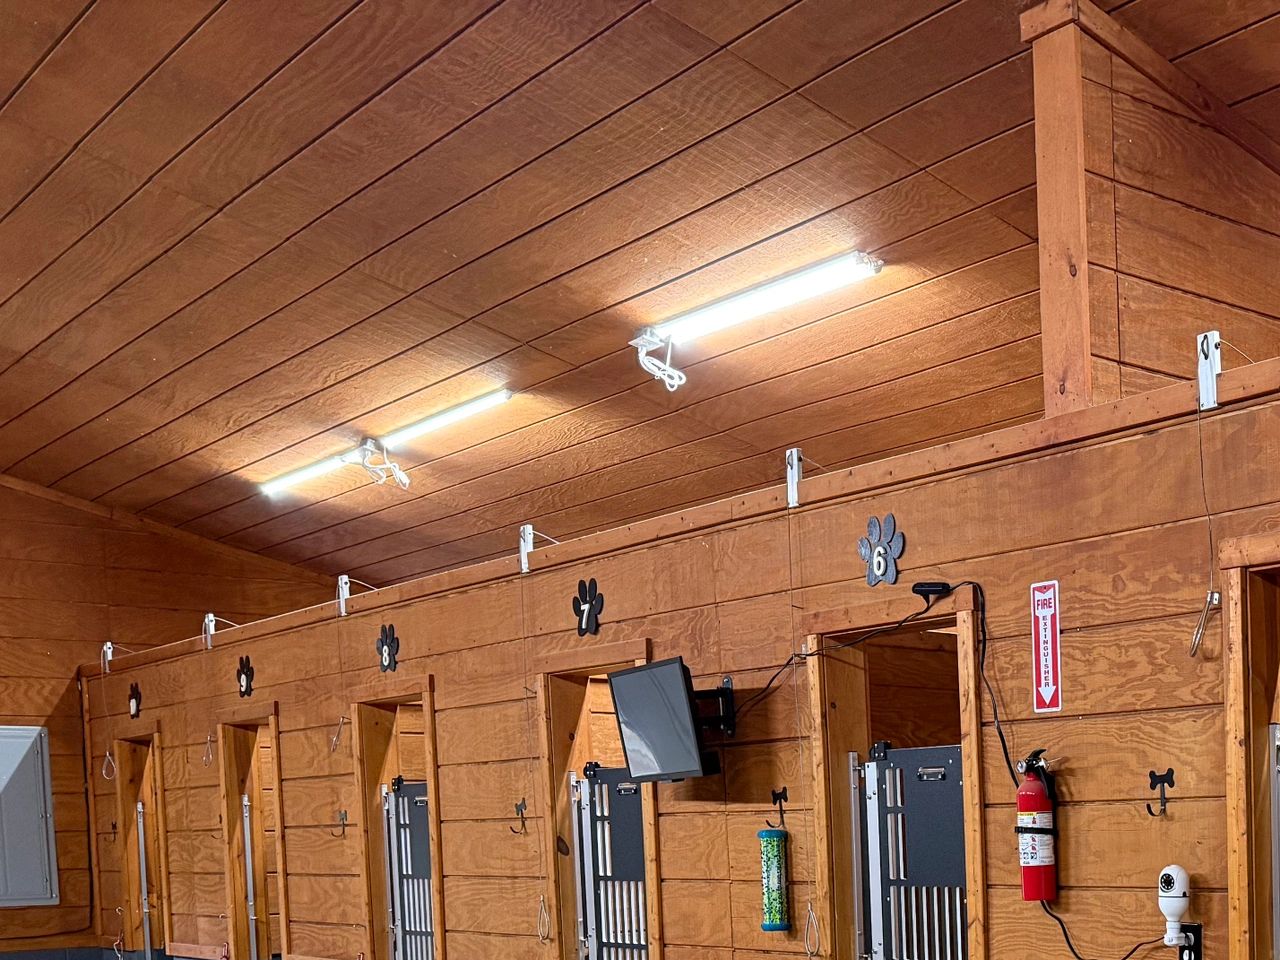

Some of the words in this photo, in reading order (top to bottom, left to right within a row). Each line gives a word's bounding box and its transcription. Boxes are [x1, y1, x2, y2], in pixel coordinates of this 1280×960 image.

[873, 546, 885, 576] 6
[1036, 597, 1053, 610] FIRE
[580, 603, 590, 629] 7
[382, 645, 390, 666] 8
[1042, 615, 1050, 688] EXTINGUISHER
[240, 674, 247, 692] 9
